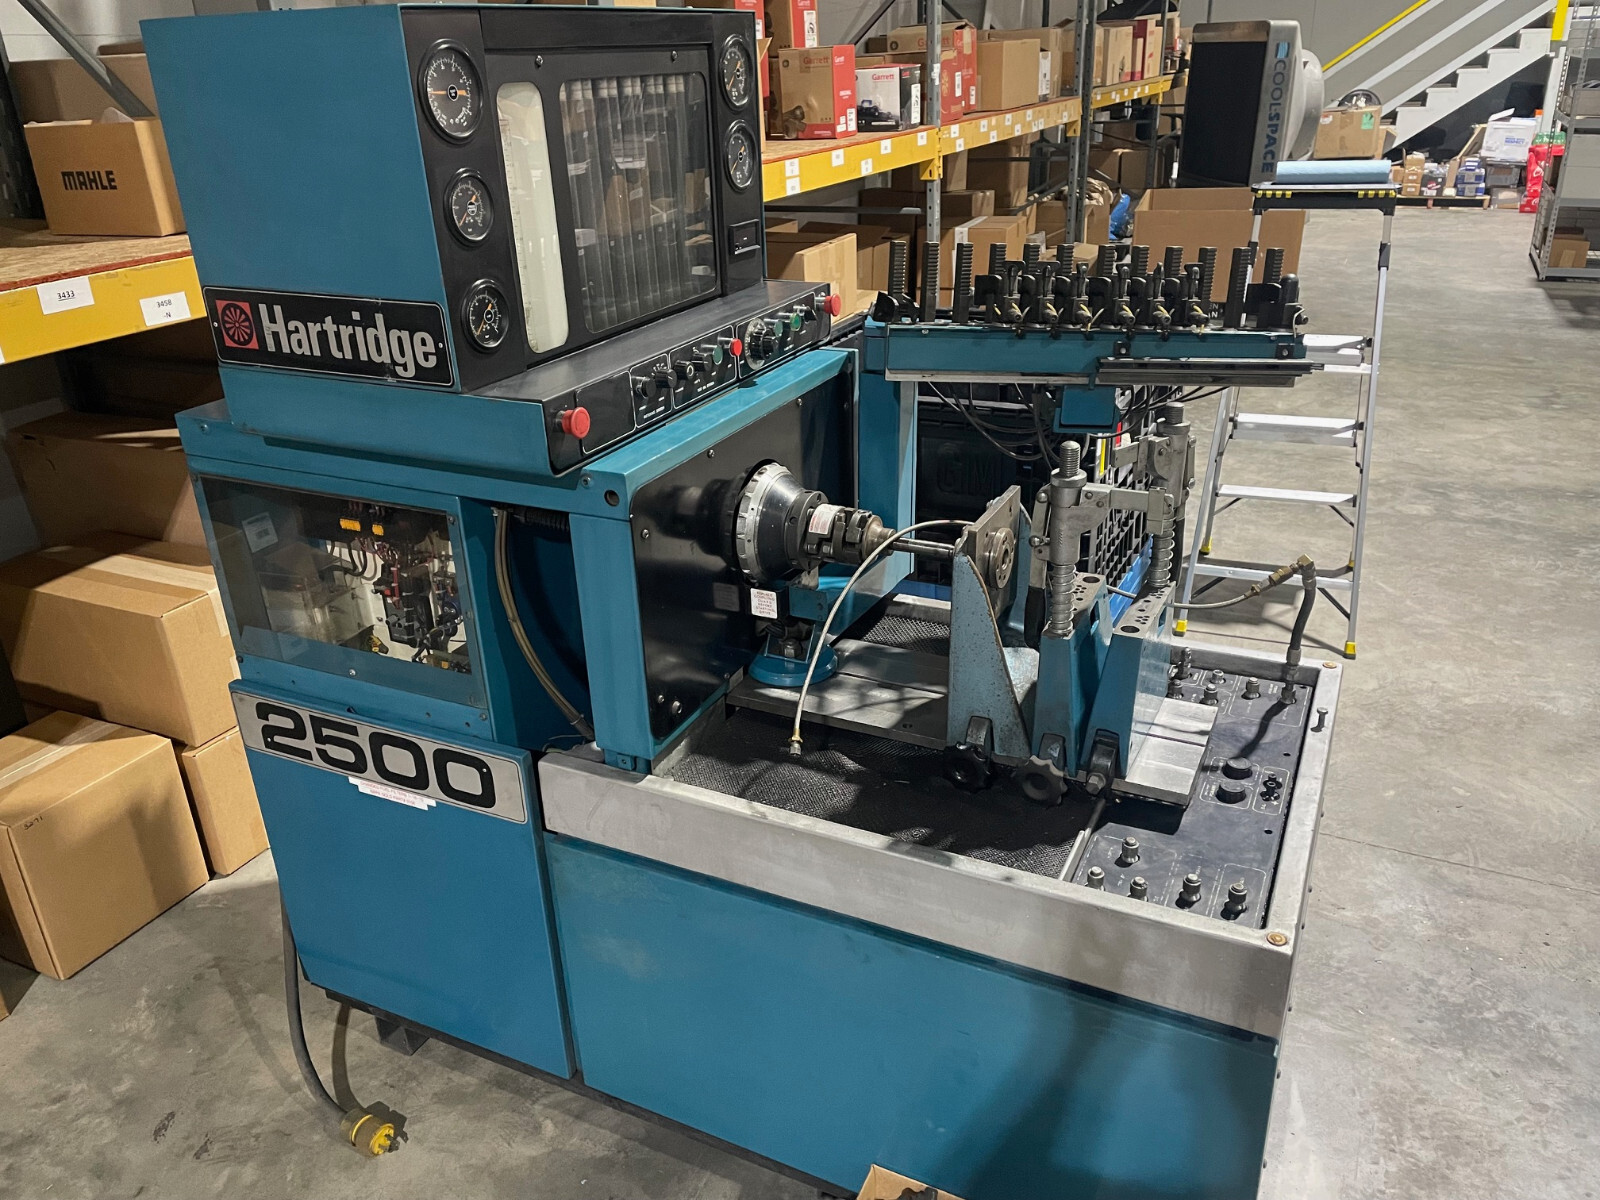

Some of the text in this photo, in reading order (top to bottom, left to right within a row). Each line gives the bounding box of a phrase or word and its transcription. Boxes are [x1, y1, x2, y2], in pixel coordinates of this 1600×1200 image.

[872, 73, 895, 81] Garrett
[61, 170, 117, 190] MAHLE
[57, 290, 75, 300] 3433
[258, 303, 437, 378] Hartridge
[255, 702, 496, 809] 2500
